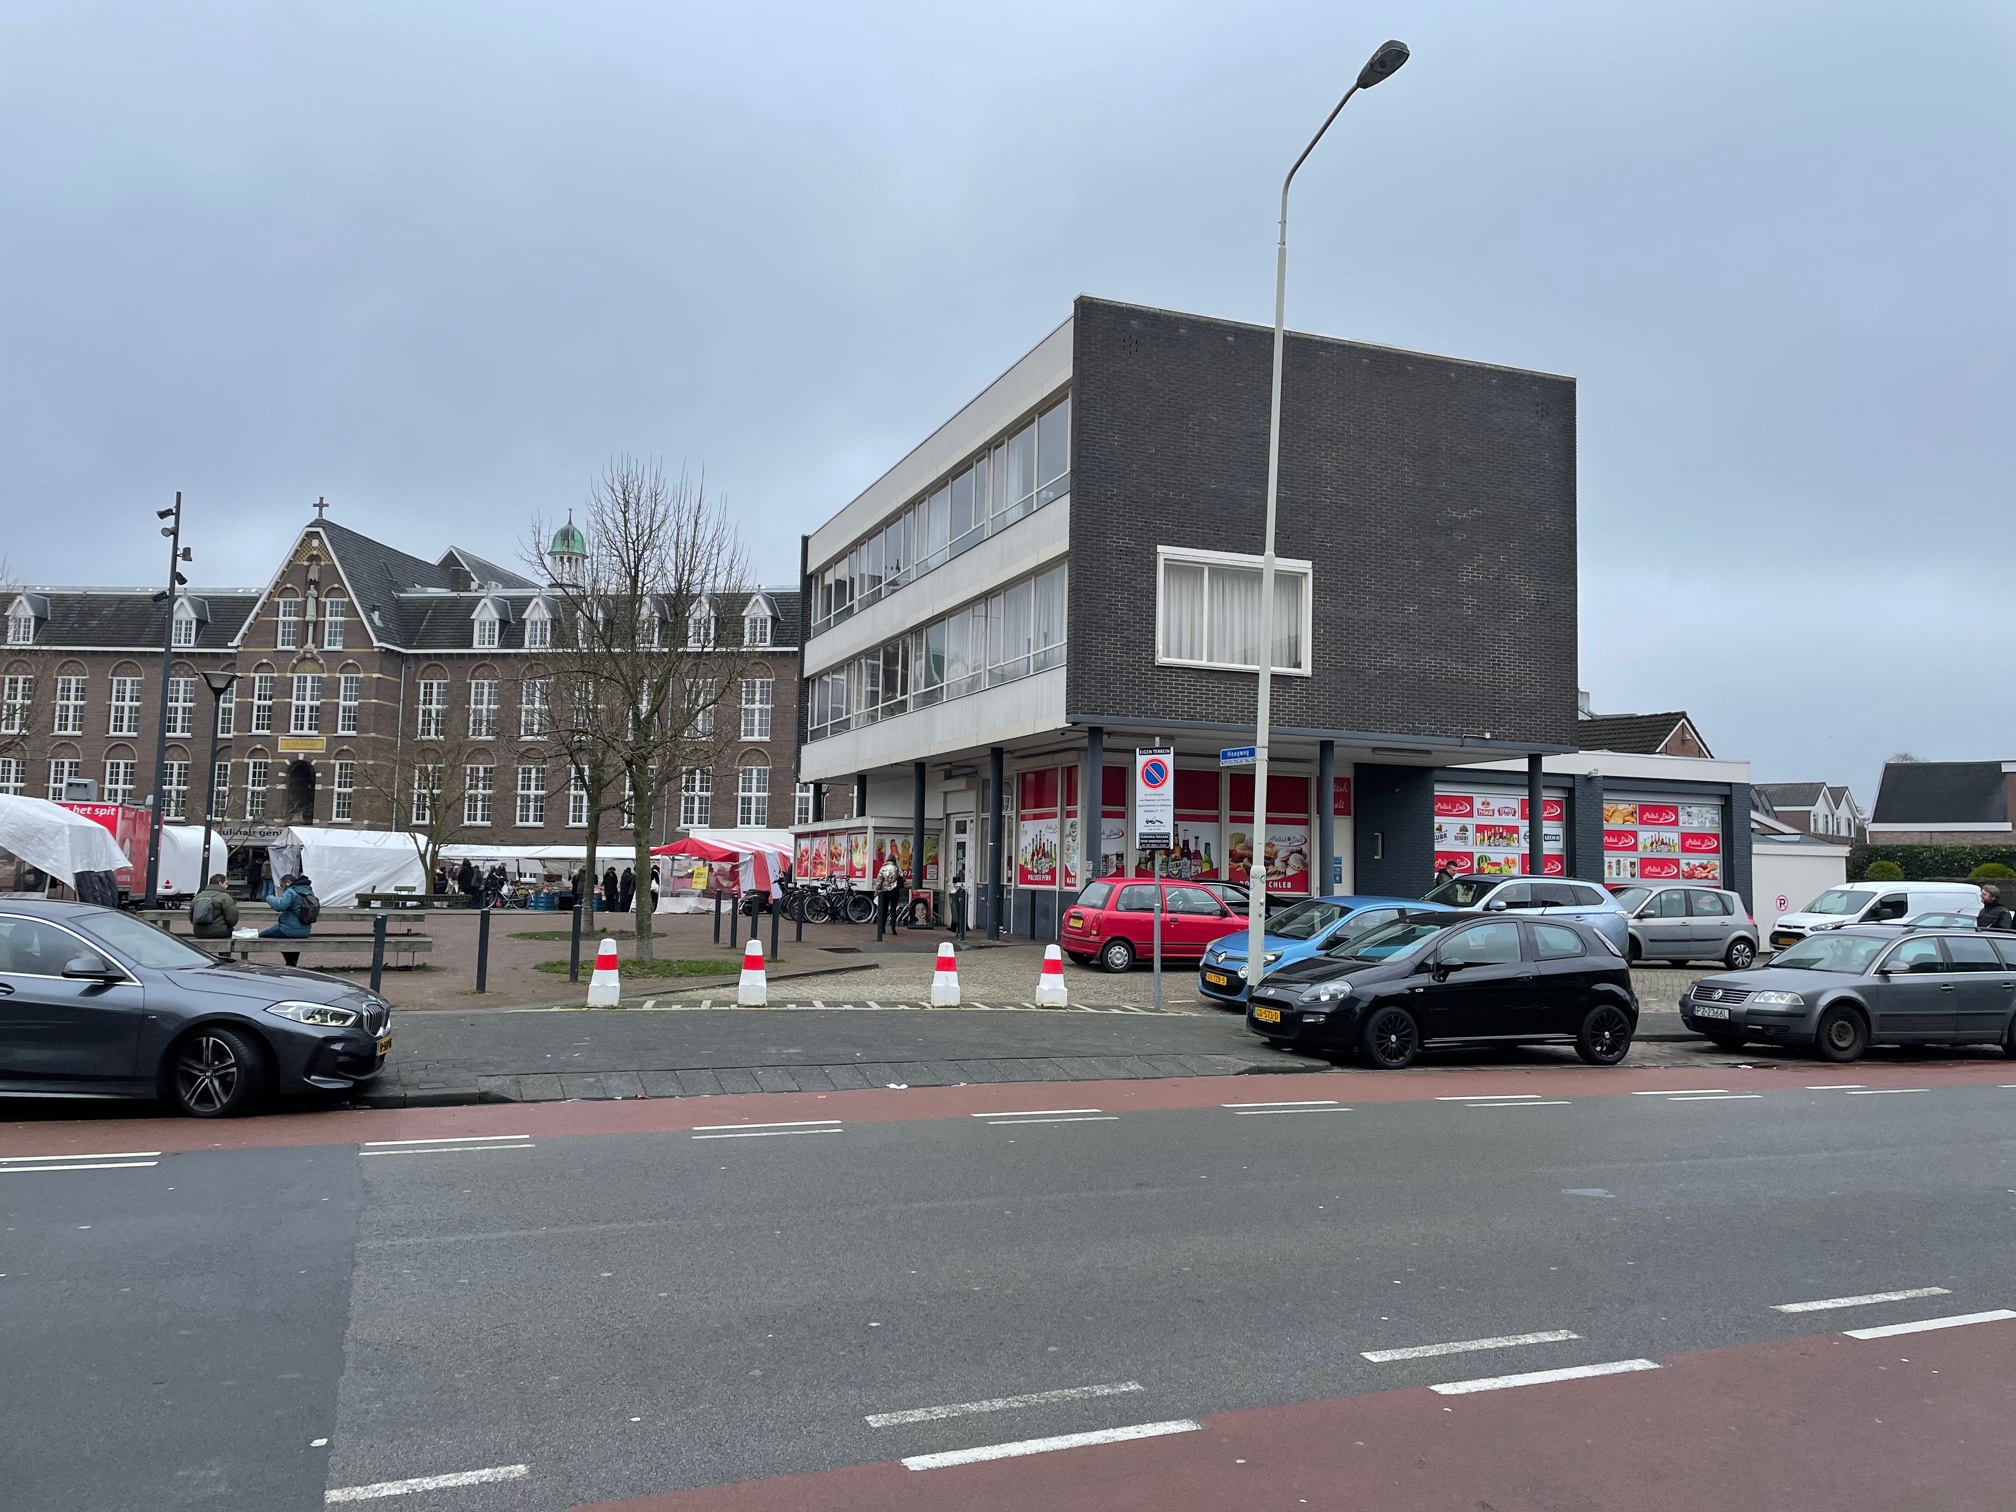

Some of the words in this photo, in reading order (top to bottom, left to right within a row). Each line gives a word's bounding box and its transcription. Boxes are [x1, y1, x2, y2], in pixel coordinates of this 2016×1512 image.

[1227, 750, 1249, 758] Haagweg
[72, 805, 93, 815] het
[94, 807, 116, 817] spit
[1477, 808, 1494, 816] TYSKIE
[217, 829, 256, 837] ulinair
[1268, 881, 1292, 889] CHLEB
